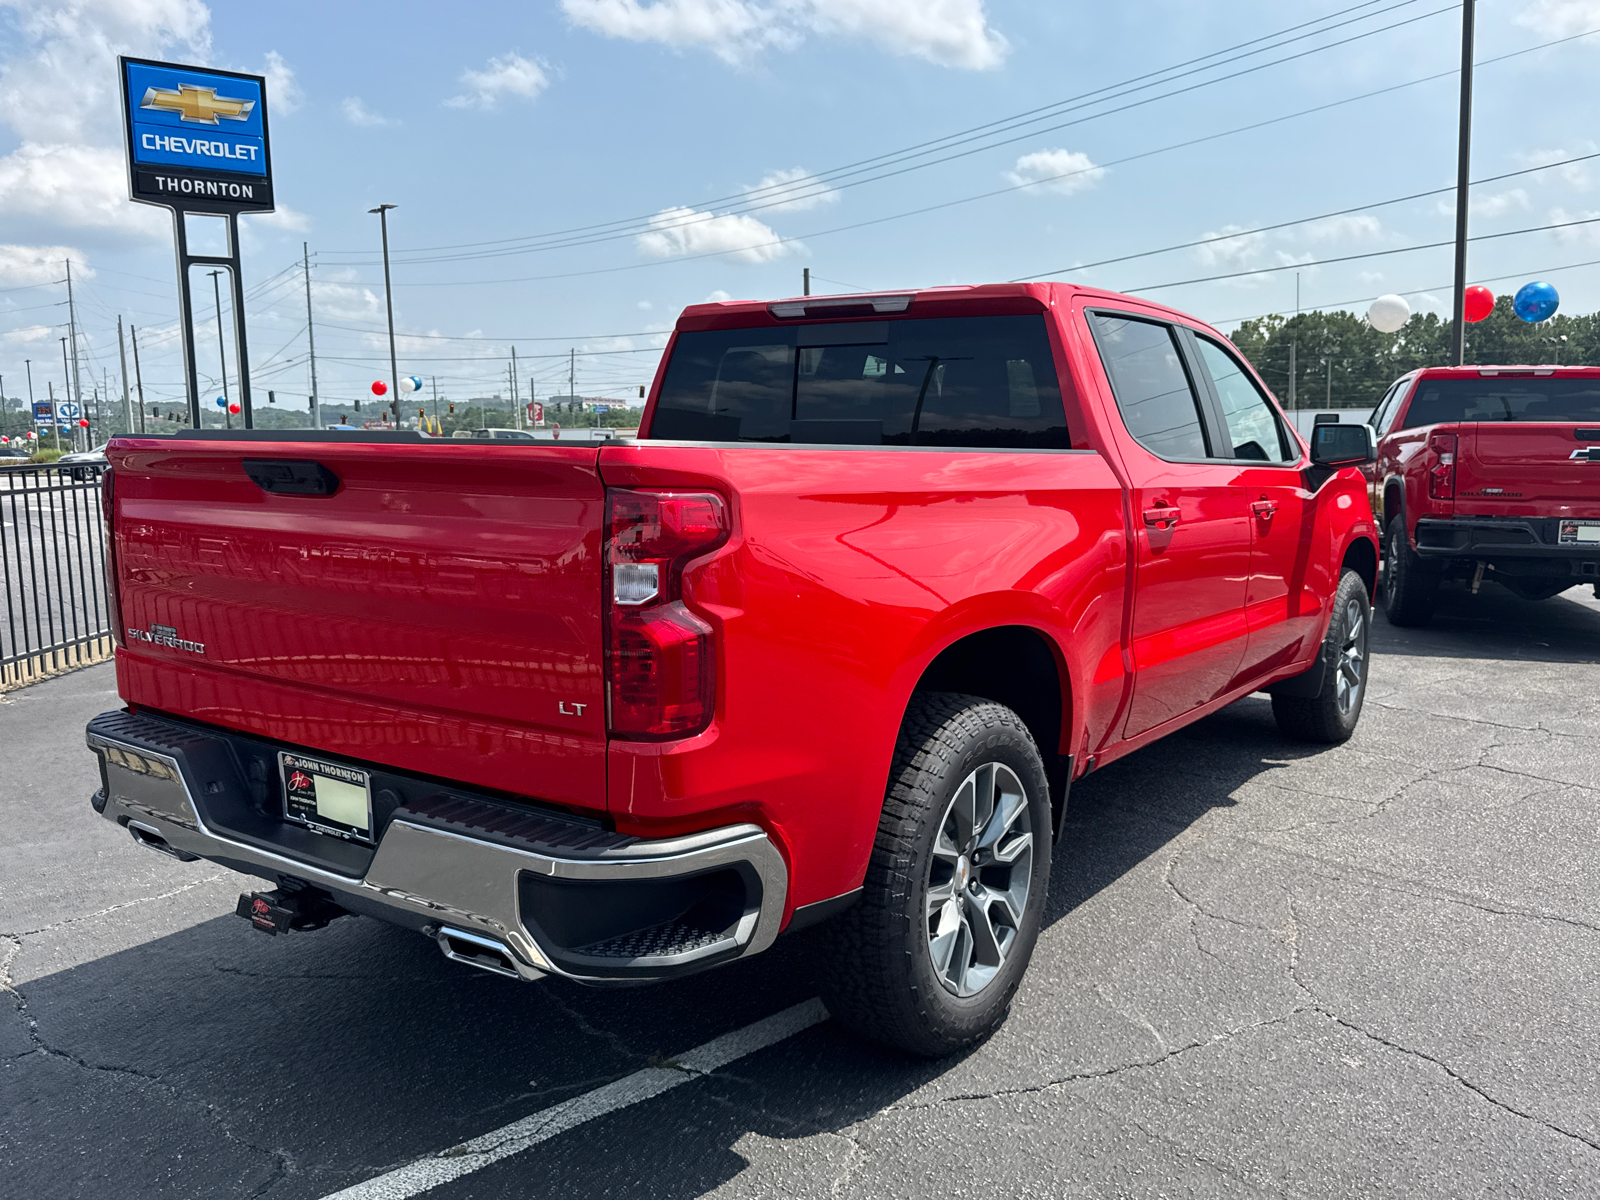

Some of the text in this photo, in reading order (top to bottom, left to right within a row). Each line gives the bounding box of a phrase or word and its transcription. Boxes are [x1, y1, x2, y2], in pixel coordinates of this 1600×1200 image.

[142, 134, 258, 160] CHEVROLET
[156, 177, 253, 198] THORNTON
[128, 628, 205, 654] SILVERADO
[559, 701, 588, 716] LT
[299, 759, 364, 783] JOHN THORNTON
[960, 733, 1048, 805] GOODYEAR
[315, 825, 342, 837] CHEVROLET
